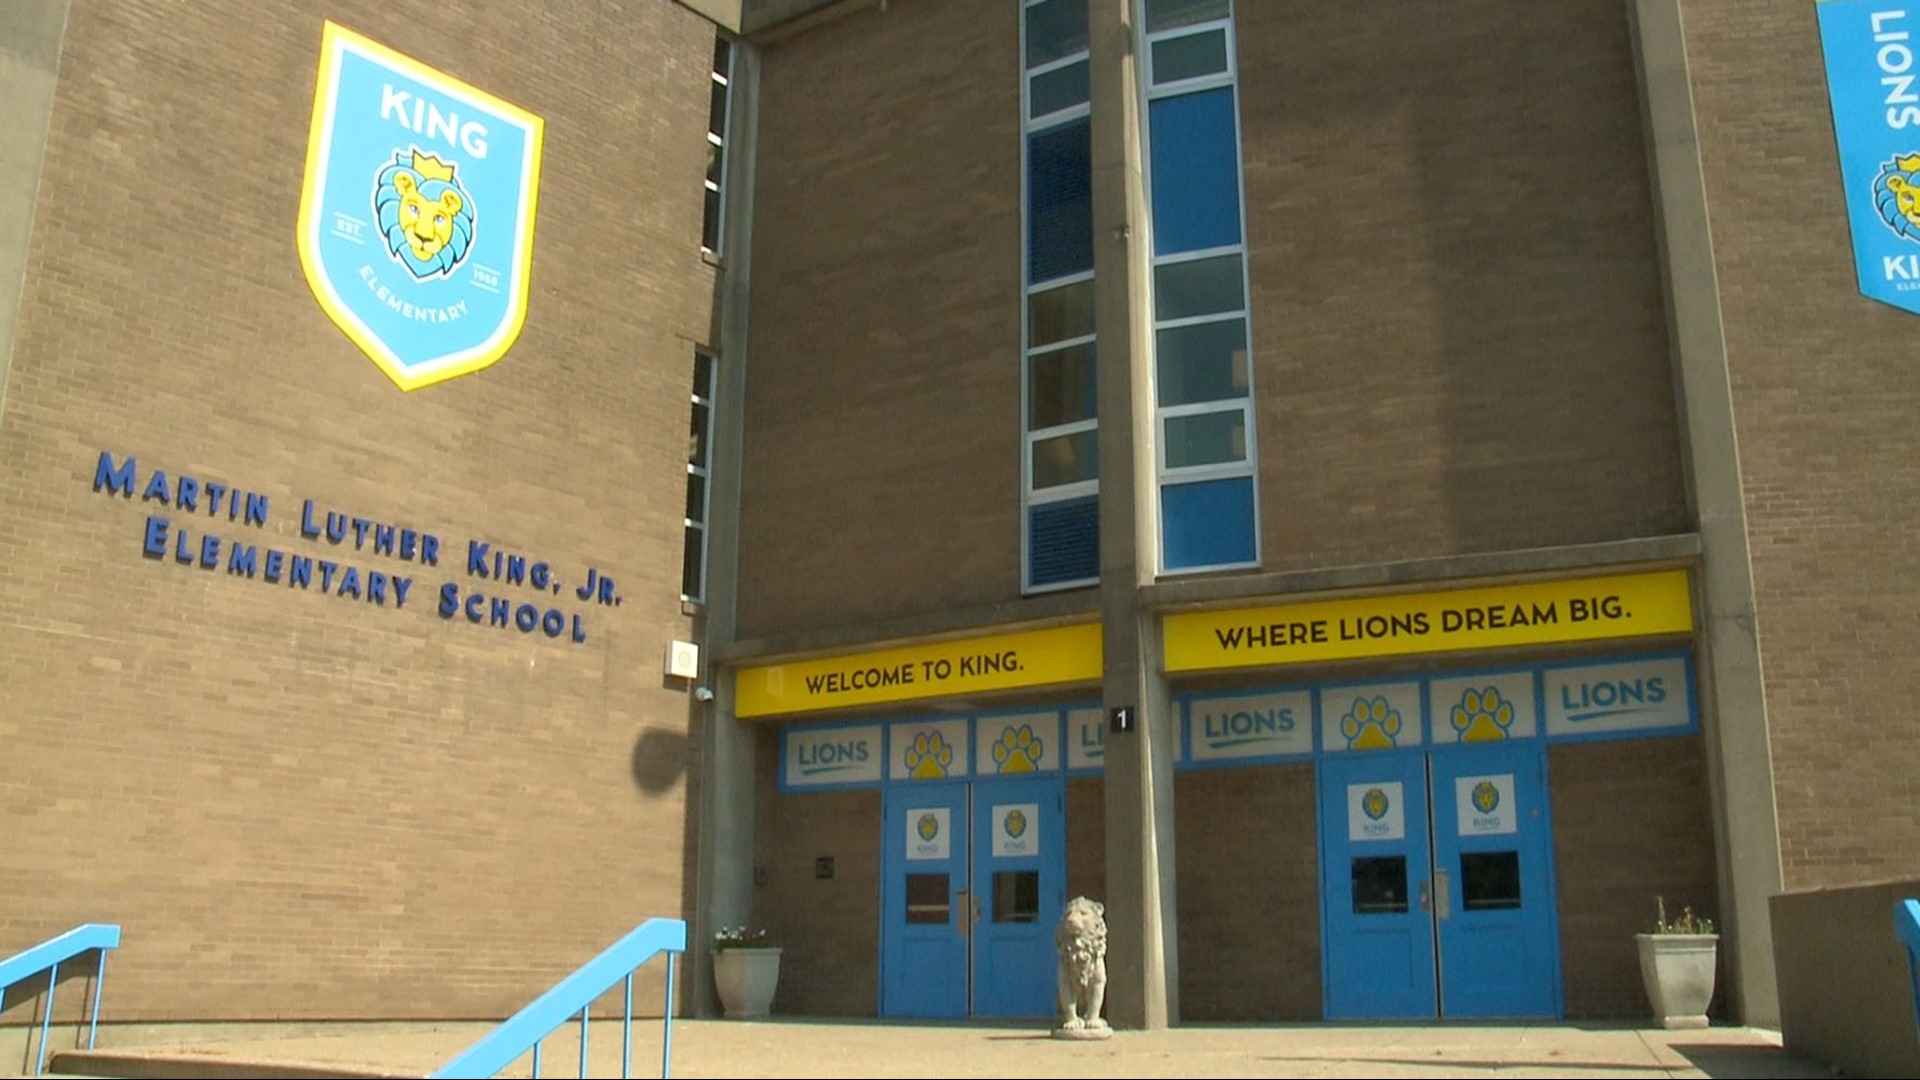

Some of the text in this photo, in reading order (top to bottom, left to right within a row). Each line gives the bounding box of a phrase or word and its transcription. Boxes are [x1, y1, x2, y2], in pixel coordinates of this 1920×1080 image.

[1870, 10, 1920, 130] LIONS
[380, 83, 489, 160] KING
[1882, 254, 1920, 281] KI
[359, 264, 468, 324] ELEMENTARY
[93, 451, 269, 526] MARTIN
[301, 499, 440, 566] LUTHER
[467, 540, 562, 596] KING,
[143, 515, 587, 643] ELEMENTARY SCHOOL
[1215, 595, 1633, 651] WHERE LIONS DREAM BIG.
[805, 651, 1025, 695] WELCOME TO KING.
[1561, 677, 1667, 711] LIONS
[1117, 709, 1127, 729] 1
[1204, 707, 1296, 739] LIONS
[798, 740, 870, 766] LIONS
